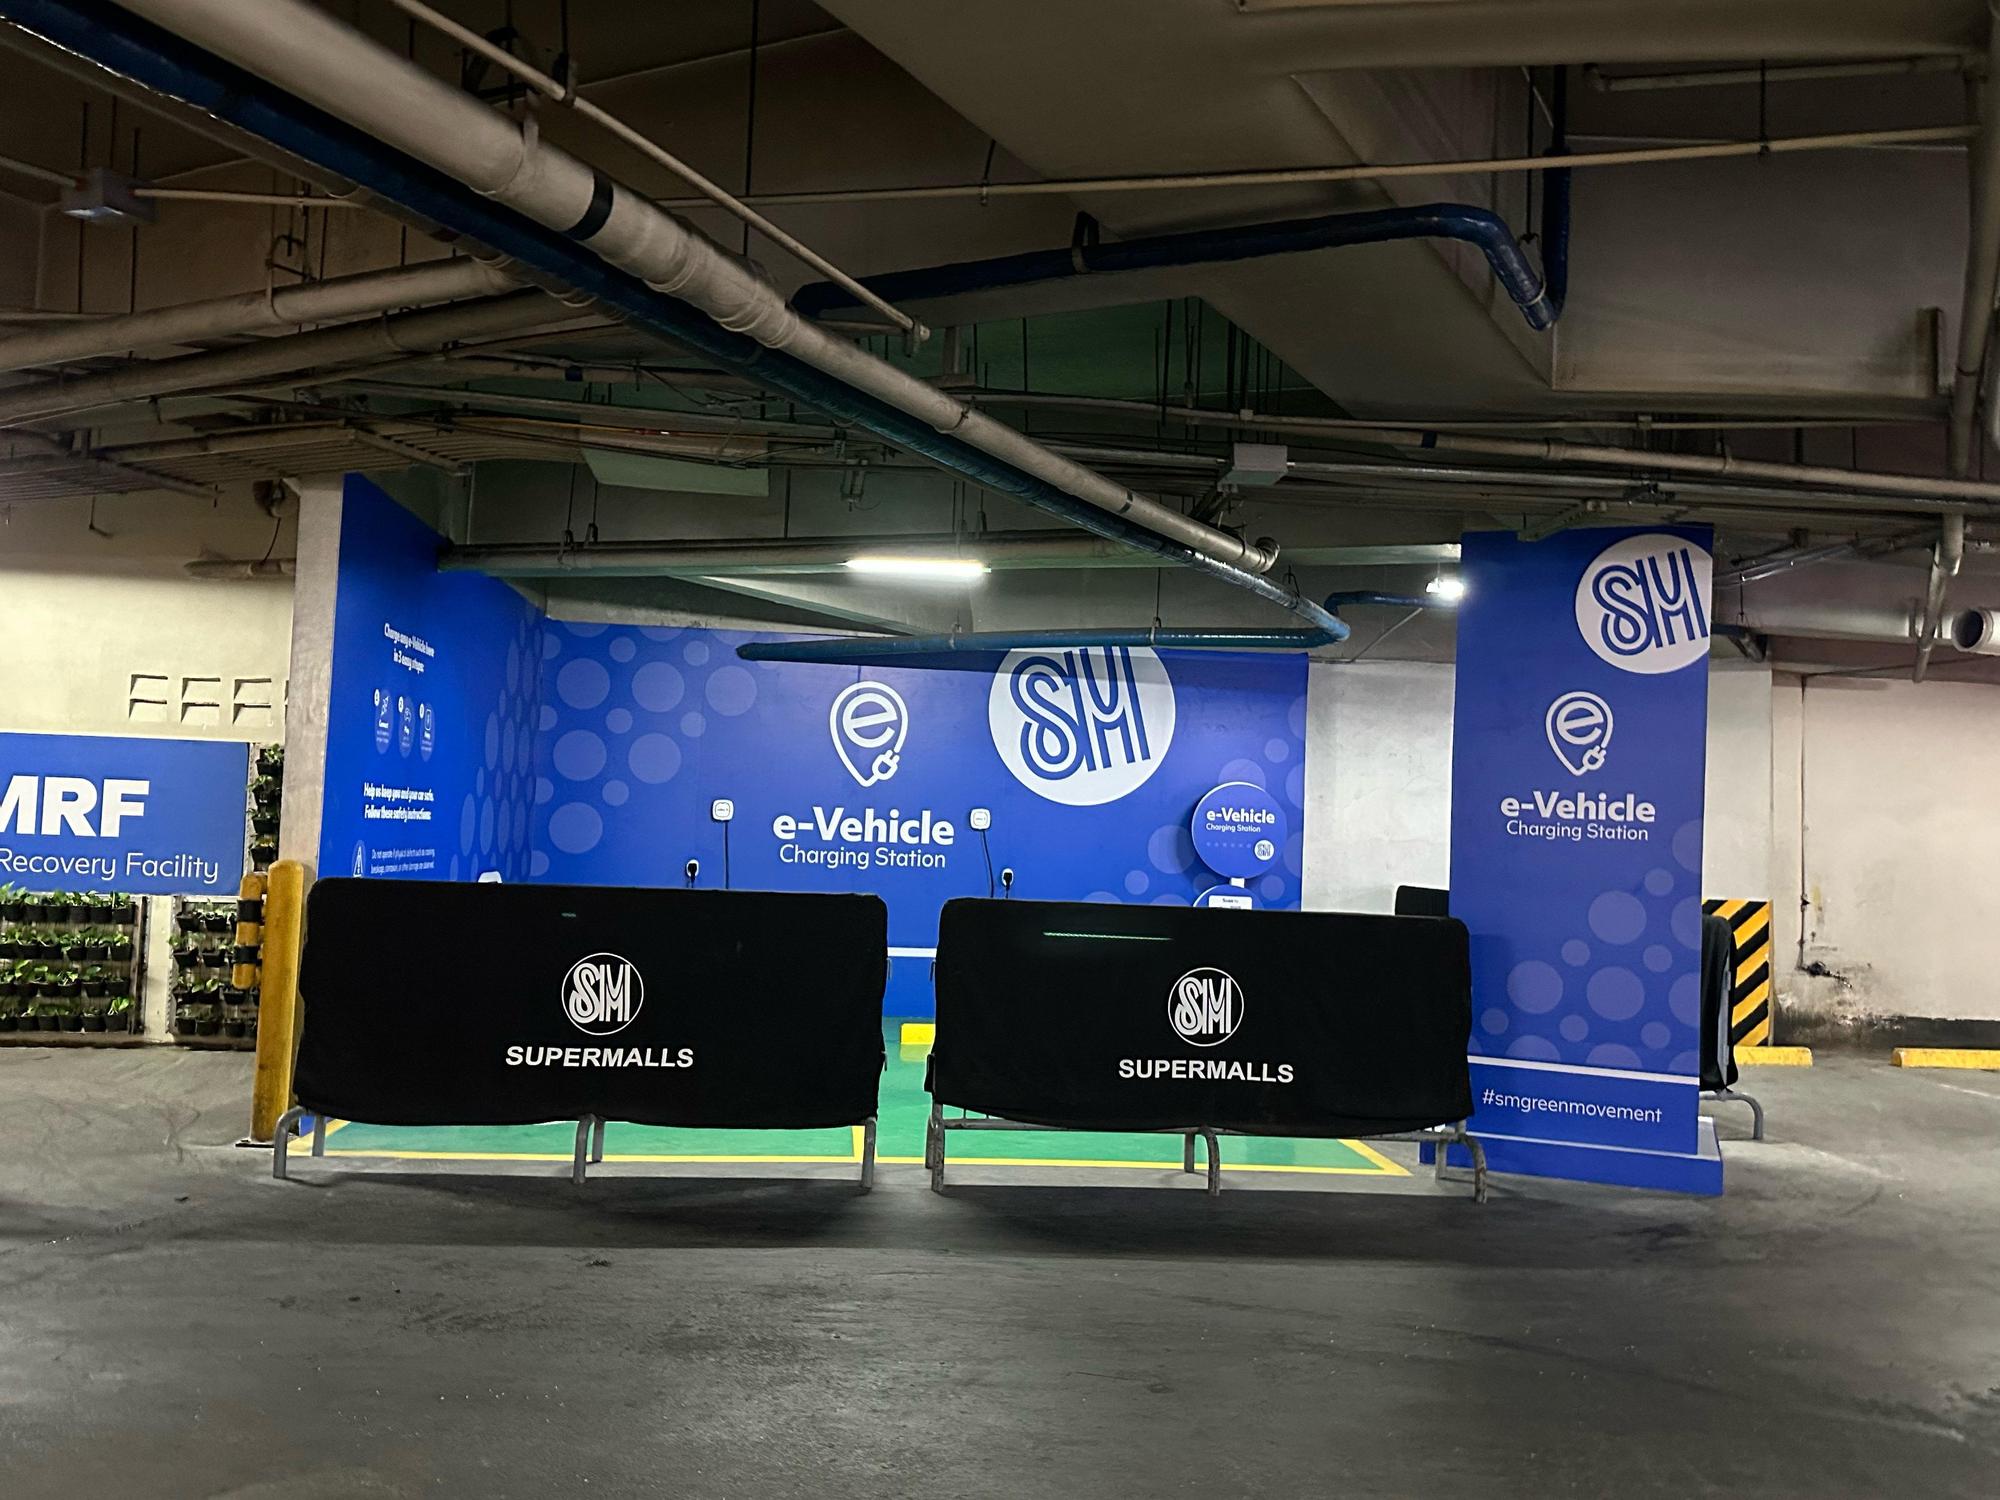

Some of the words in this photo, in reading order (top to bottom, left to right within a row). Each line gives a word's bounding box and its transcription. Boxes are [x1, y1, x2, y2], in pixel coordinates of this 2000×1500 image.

[1592, 549, 1708, 656] SM
[1010, 646, 1151, 780] SM
[1207, 807, 1275, 824] e-Vehicle
[1501, 791, 1656, 822] e-Vehicle
[773, 807, 954, 846] e-Vehicle
[1206, 822, 1236, 833] Charging
[1237, 824, 1261, 832] Station
[1507, 820, 1582, 841] Charging
[1587, 823, 1649, 841] Station
[0, 848, 116, 880] Recovery
[126, 853, 219, 884] Facility
[780, 844, 869, 869] Charging
[875, 847, 946, 868] Station
[569, 963, 631, 1024] SM
[1174, 976, 1232, 1036] SM
[505, 1045, 694, 1068] SUPERMALLS
[1118, 1059, 1294, 1083] SUPERMALLS
[1482, 1088, 1662, 1123] #smgreenmovement
